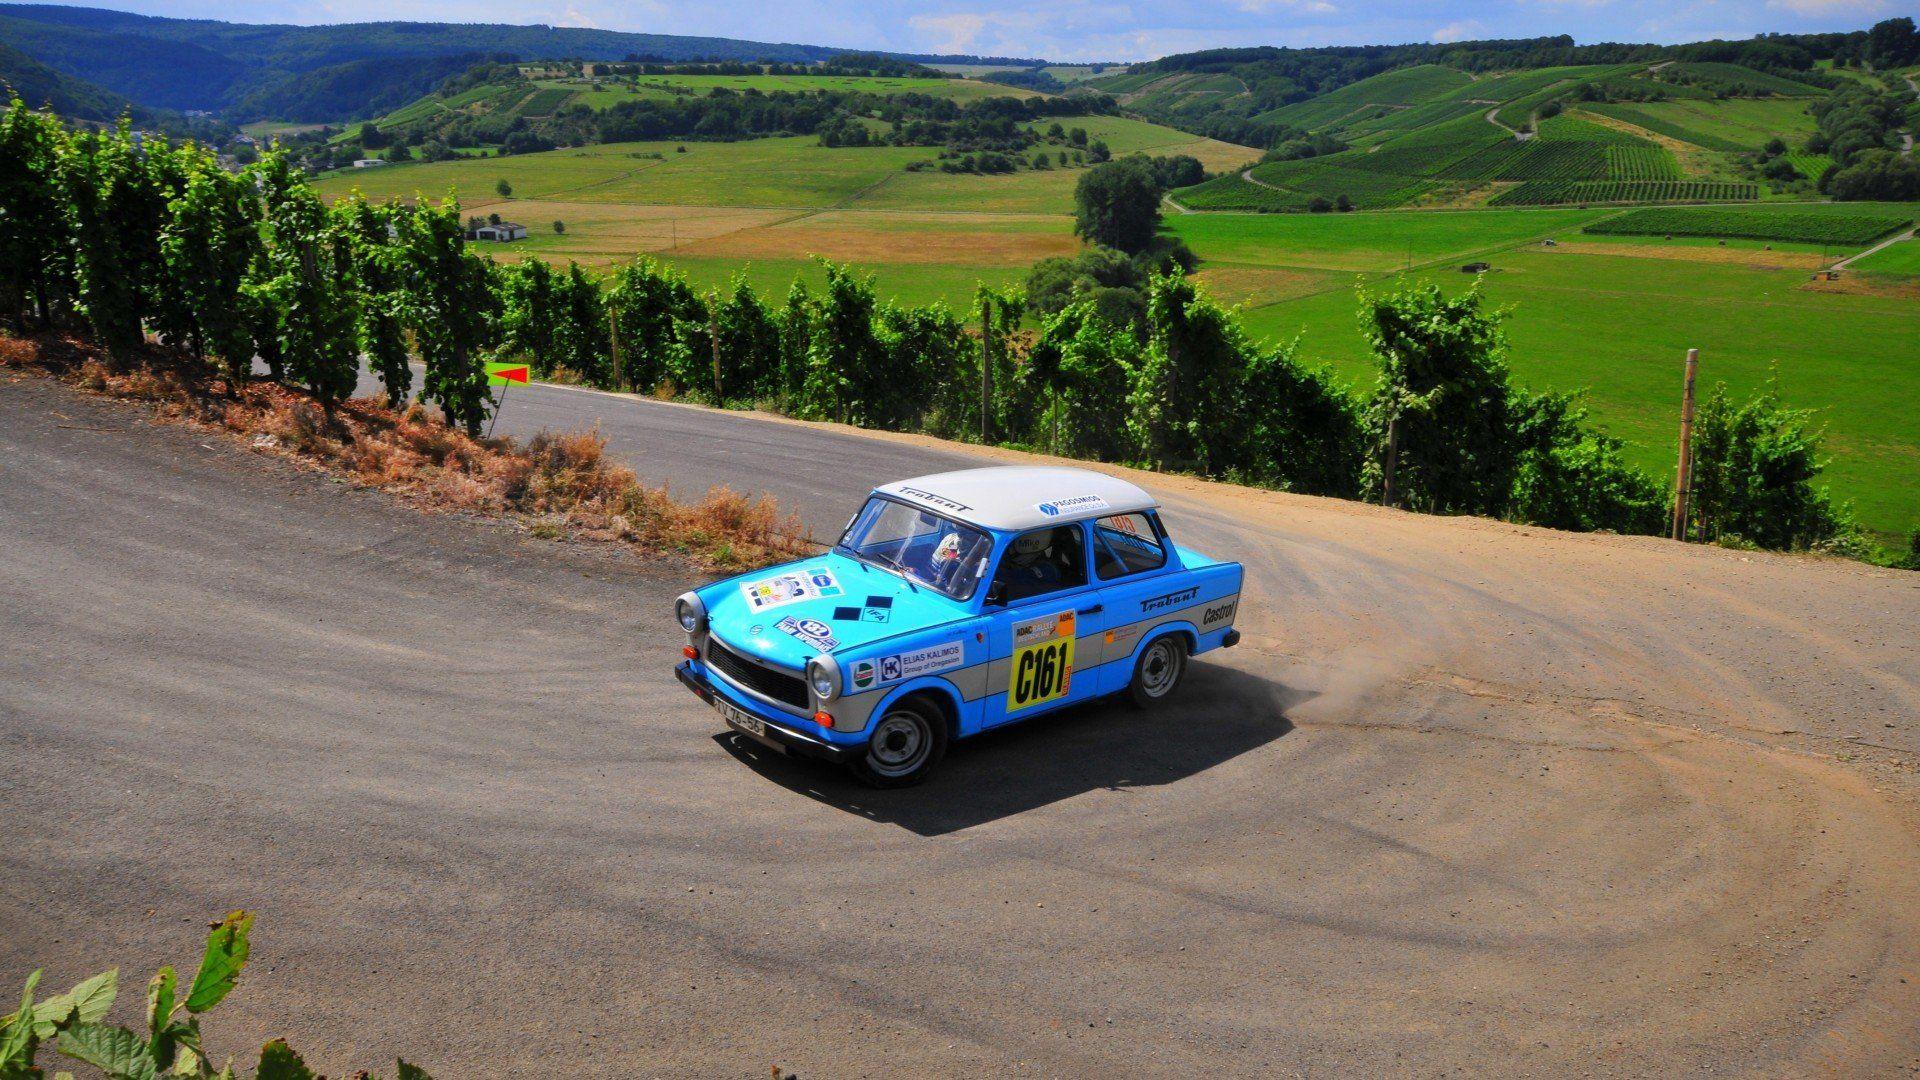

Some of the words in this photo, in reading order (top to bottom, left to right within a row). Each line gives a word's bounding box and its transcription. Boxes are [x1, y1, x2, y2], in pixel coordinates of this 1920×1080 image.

[899, 486, 974, 512] Trabant
[1140, 585, 1200, 613] Trabant
[1203, 600, 1236, 625] Castrol
[903, 653, 925, 665] ELIAS
[926, 646, 960, 660] KALIMOS
[1015, 642, 1068, 704] C161
